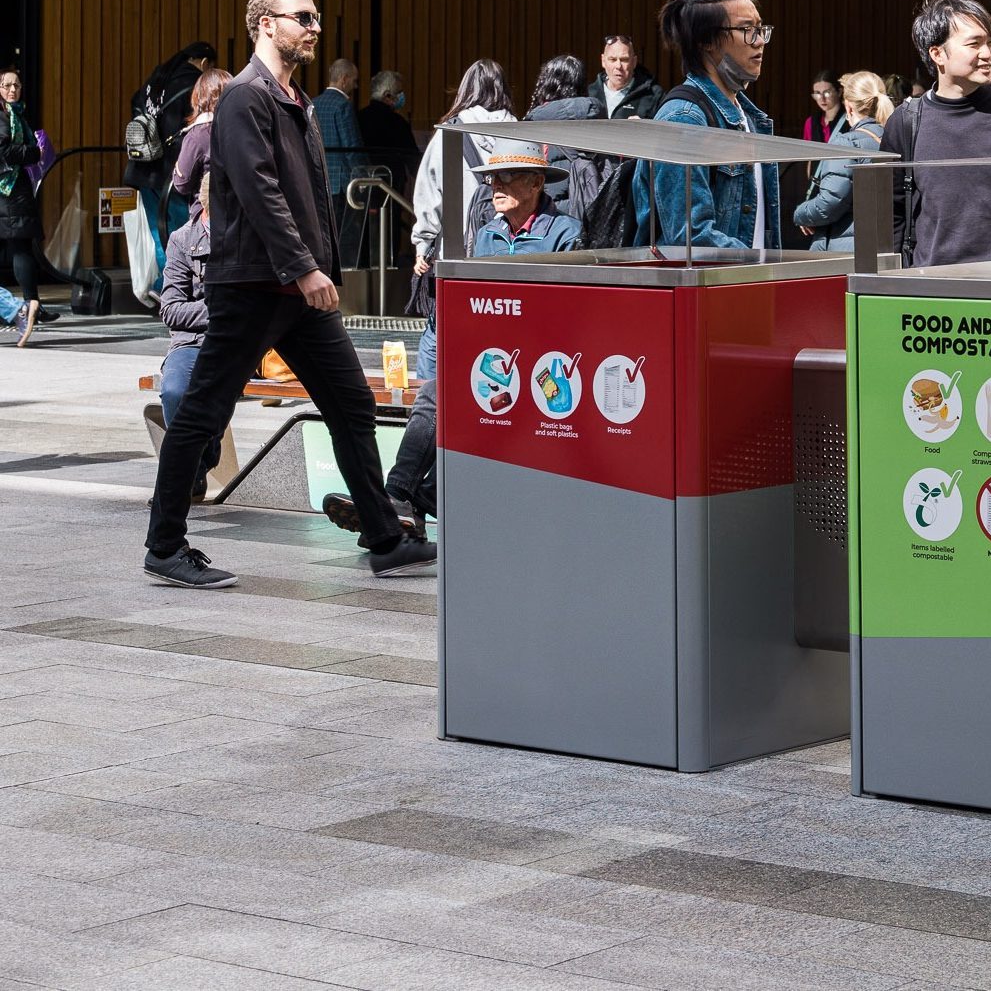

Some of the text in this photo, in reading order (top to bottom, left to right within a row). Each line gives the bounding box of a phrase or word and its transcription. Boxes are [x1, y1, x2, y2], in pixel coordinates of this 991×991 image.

[470, 297, 521, 315] WASTE
[902, 314, 953, 333] FOOD
[541, 422, 558, 430] Plastic
[558, 430, 578, 438] plastics
[608, 427, 631, 435] Receipts
[972, 458, 991, 466] straws
[930, 545, 955, 553] labelled
[913, 552, 953, 561] compostable
